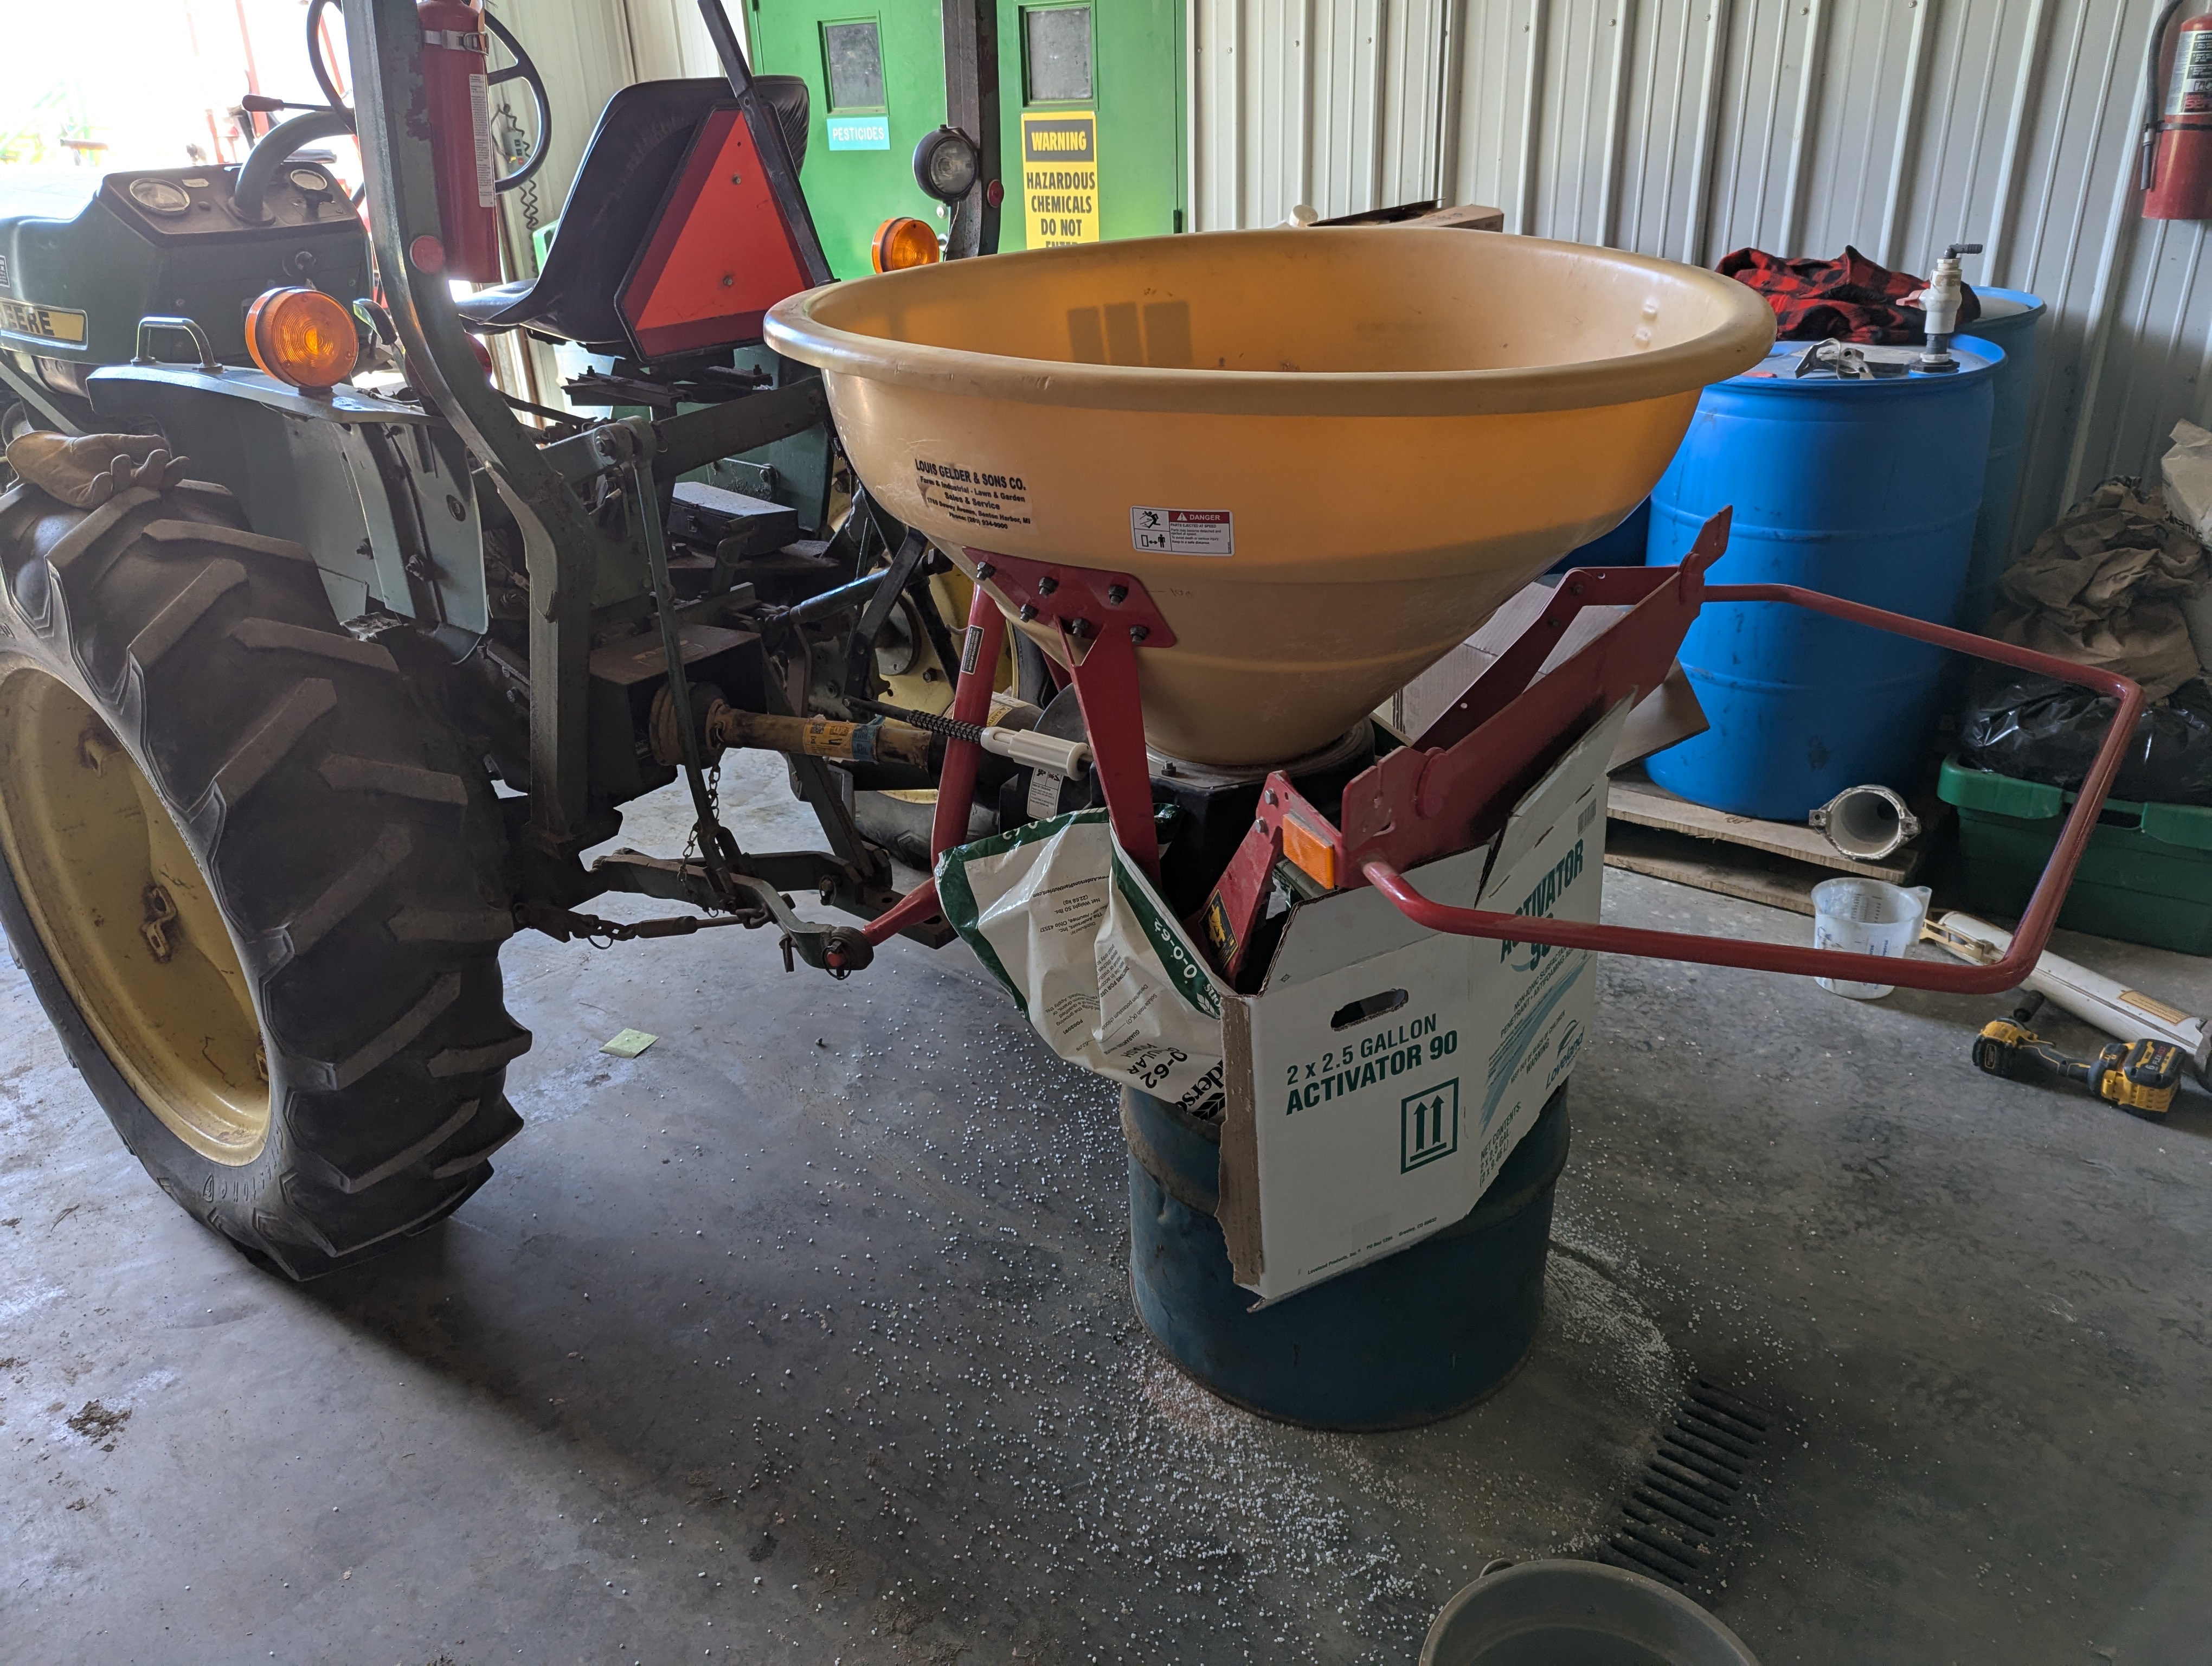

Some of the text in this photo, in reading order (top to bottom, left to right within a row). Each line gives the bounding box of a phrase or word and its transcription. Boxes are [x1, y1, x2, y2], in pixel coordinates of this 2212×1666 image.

[832, 127, 884, 142] PESTICIDES
[1031, 131, 1086, 151] WARNING
[1026, 172, 1095, 190] HAZARDOUS
[1031, 195, 1092, 214] CHEMICALS
[1041, 218, 1082, 236] DO NOT
[0, 303, 54, 336] EERE
[915, 458, 1026, 491] LOUIS GELDER & SONS CO.
[920, 476, 935, 485] Farm
[941, 480, 969, 494] Industrial
[974, 488, 992, 498] Lawn
[1000, 492, 1025, 502] Garden
[944, 491, 1000, 510] Sales & Service
[1072, 901, 1091, 909] Weight
[1068, 913, 1089, 922] Maumee,
[1069, 917, 1092, 930] Andersons,
[1076, 921, 1096, 932] Distributed
[1040, 925, 1054, 933] 43537
[1101, 953, 1109, 962] only
[1154, 918, 1197, 978] 0-0-62
[1108, 980, 1117, 990] FOR
[1514, 976, 1539, 1011] NON-IONIC
[1054, 998, 1068, 1008] Apply
[1057, 1001, 1072, 1011] drains,
[1501, 997, 1530, 1038] PENETRANT
[1533, 955, 1565, 998] ANTIFOAMING
[1059, 1004, 1078, 1018] qualified
[1114, 999, 1133, 1018] potassium
[1056, 1013, 1074, 1026] growing
[1063, 1019, 1083, 1035] F002091
[1287, 1013, 1436, 1086] 2 x 2.5 GALLON
[1526, 1037, 1549, 1075] WARNING
[1545, 1025, 1585, 1091] Loveland
[1285, 1043, 1422, 1116] ACTIVATOR
[1429, 1030, 1457, 1061] 90
[1481, 1101, 1521, 1162] NET CONTENTS:
[1480, 1162, 1484, 1174] 2
[1485, 1158, 1488, 1168] x
[1499, 1128, 1512, 1148] GAL.
[1480, 1171, 1486, 1188] (2
[1487, 1167, 1490, 1177] x
[1503, 1138, 1509, 1153] L)
